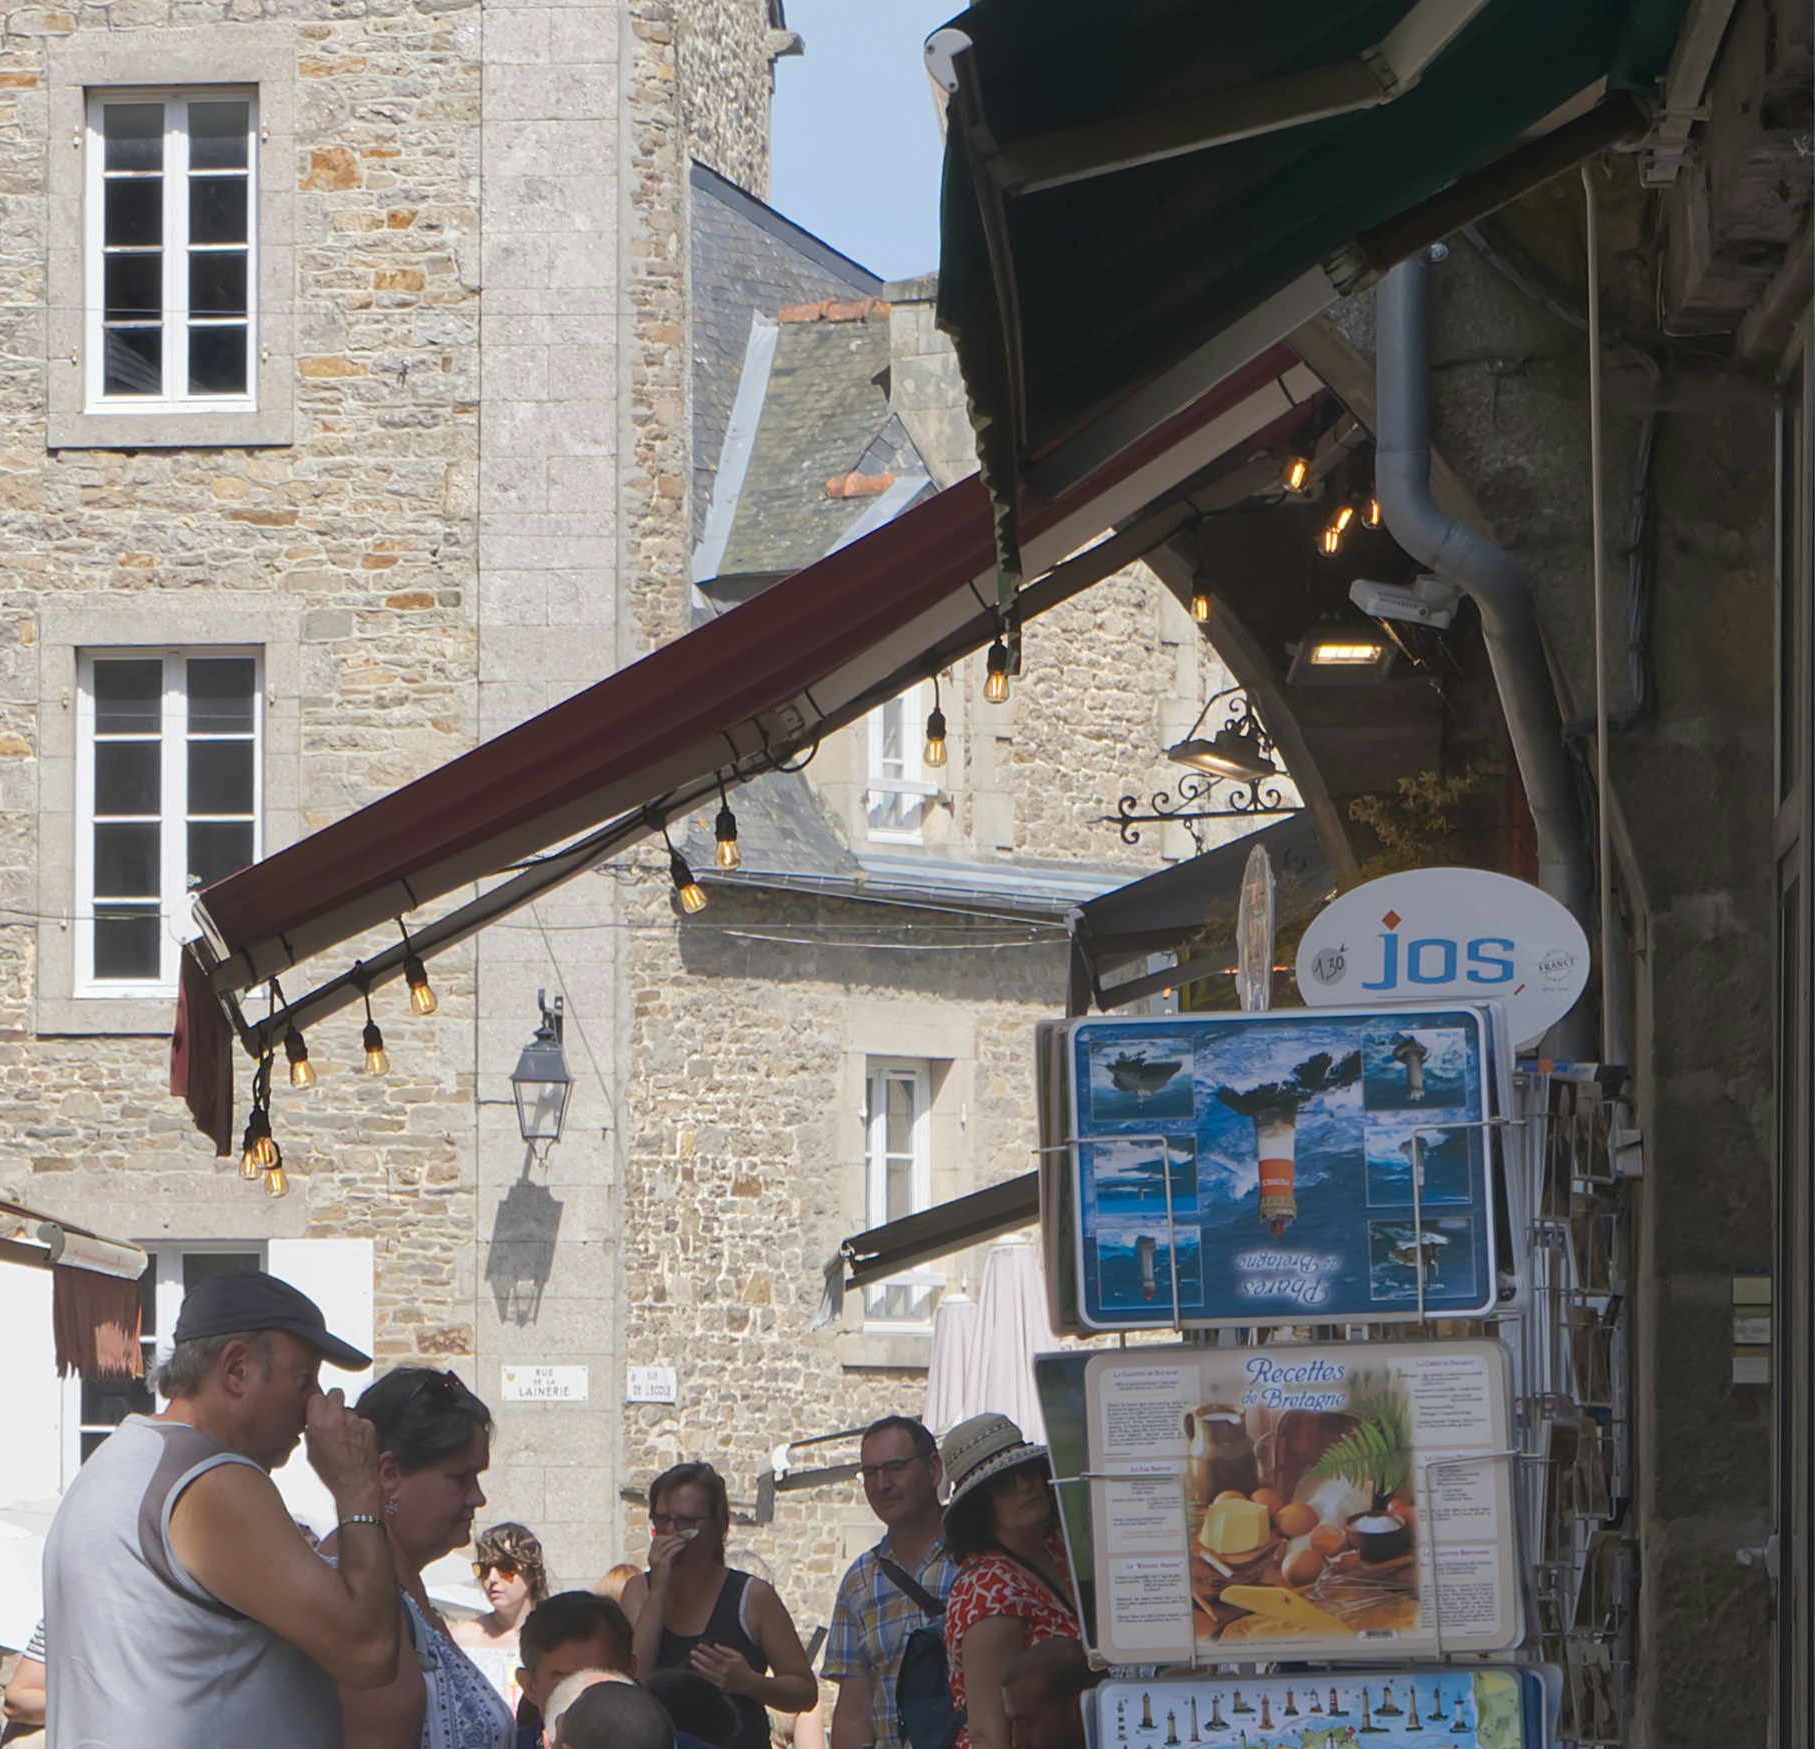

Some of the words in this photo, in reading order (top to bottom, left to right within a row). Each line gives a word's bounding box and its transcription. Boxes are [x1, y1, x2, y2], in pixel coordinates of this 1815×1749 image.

[1361, 909, 1516, 991] jos
[1237, 1251, 1320, 1275] Bretagne
[1242, 1277, 1331, 1305] Phares
[535, 1368, 554, 1377] RUE
[1245, 1356, 1346, 1386] Recettes
[518, 1386, 570, 1398] LAINERIE
[1241, 1389, 1258, 1405] de
[1261, 1387, 1346, 1413] Bretagne
